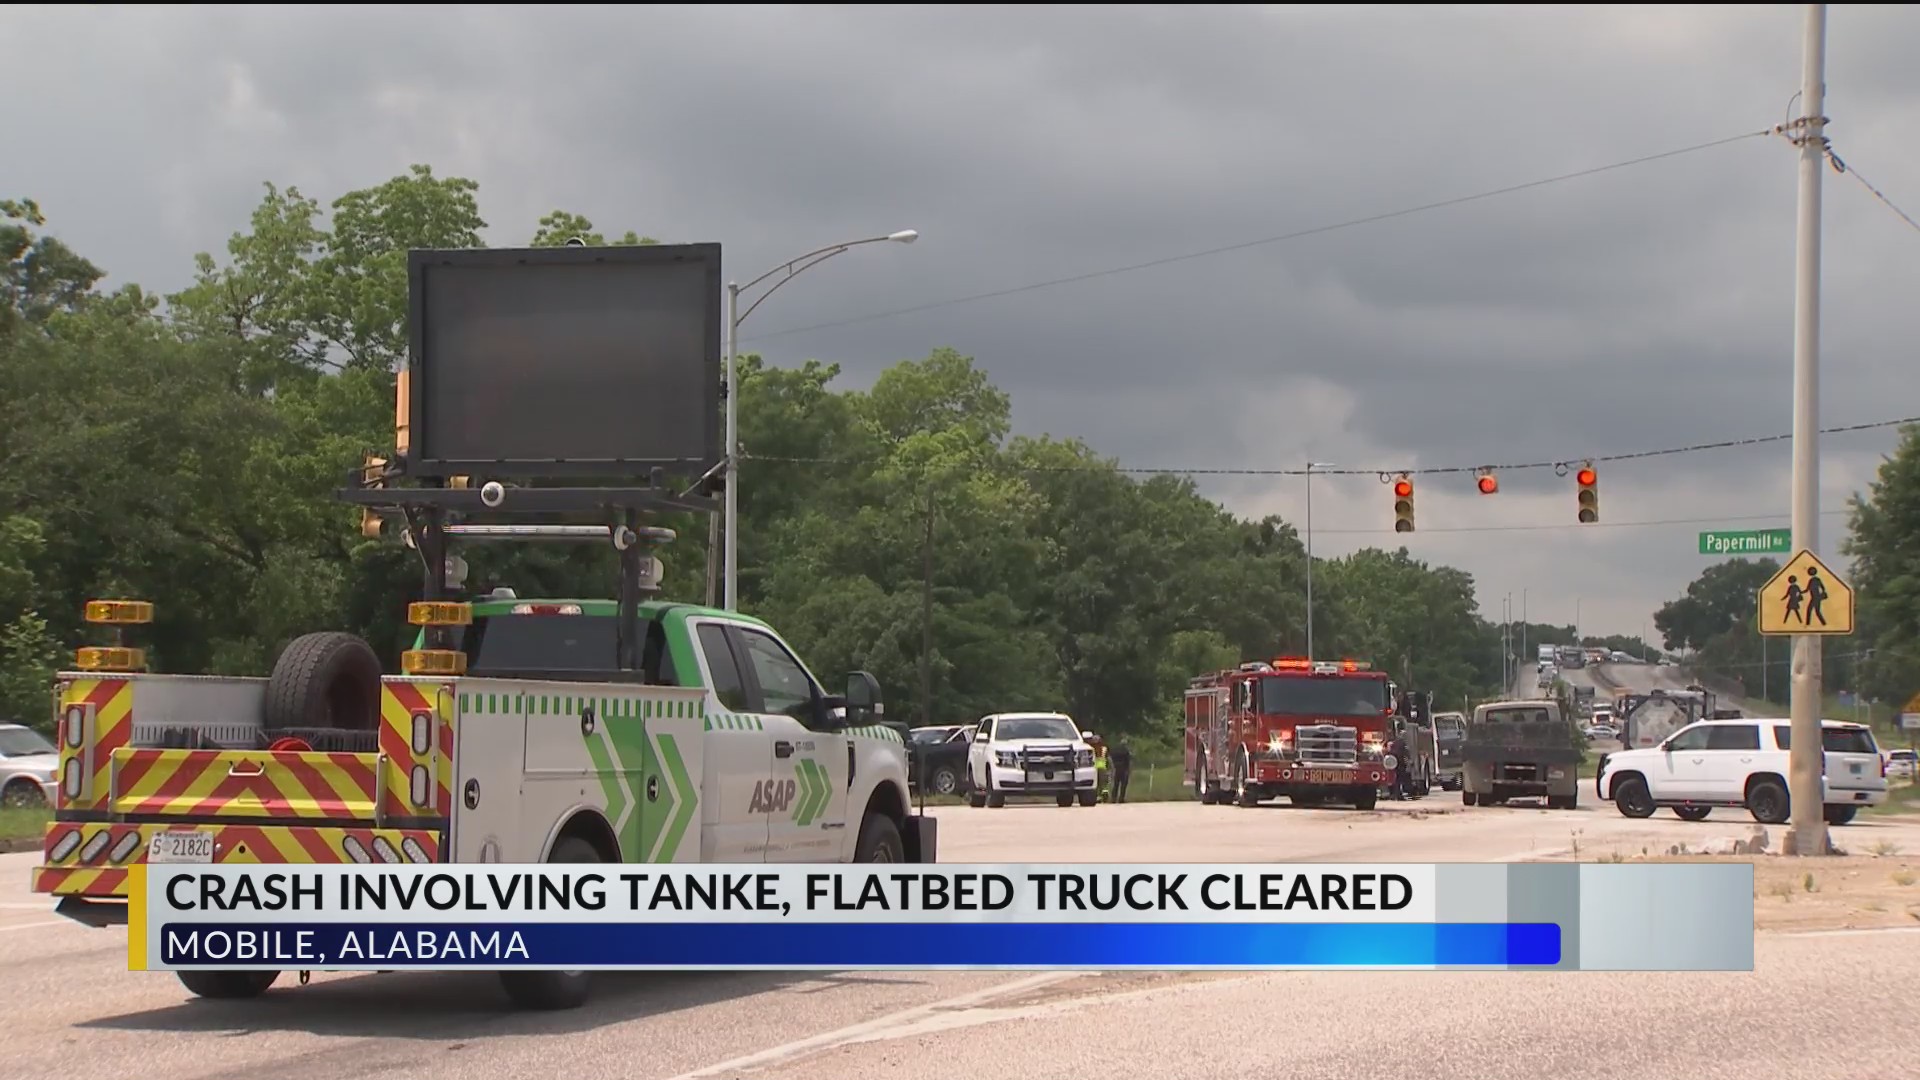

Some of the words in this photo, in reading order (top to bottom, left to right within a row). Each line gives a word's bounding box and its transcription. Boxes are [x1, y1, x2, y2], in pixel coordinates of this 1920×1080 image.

[1706, 533, 1772, 553] Papermill
[1773, 536, 1783, 546] Rd
[747, 778, 796, 814] ASAP
[152, 838, 162, 855] S
[172, 838, 211, 856] 2182C
